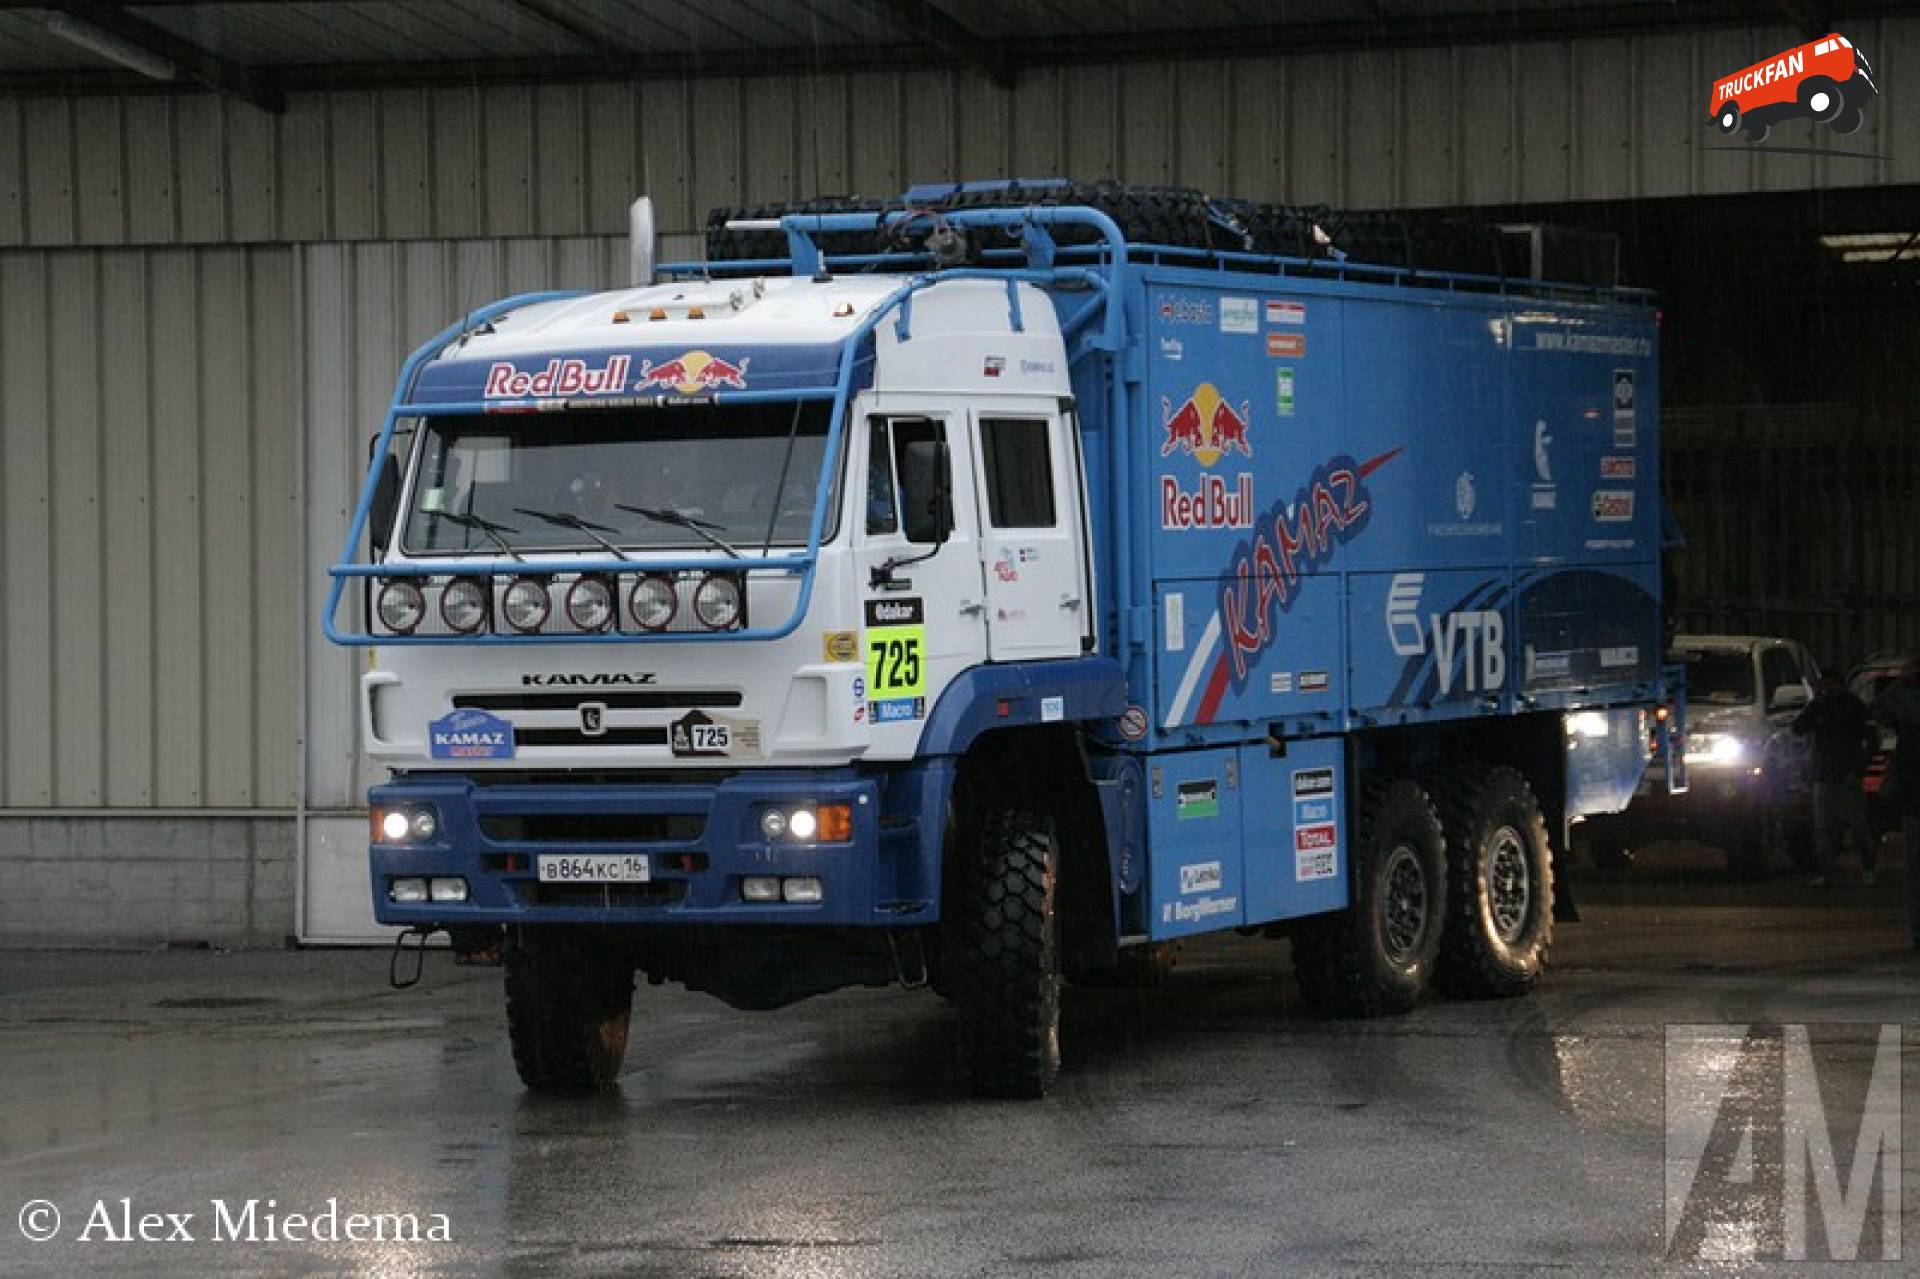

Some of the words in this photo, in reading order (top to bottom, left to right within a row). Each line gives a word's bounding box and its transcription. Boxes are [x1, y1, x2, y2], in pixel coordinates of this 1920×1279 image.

[485, 361, 560, 397] Red
[556, 355, 631, 394] Bull
[1161, 474, 1208, 530] Red
[1208, 473, 1254, 528] Bull
[1223, 469, 1369, 680] KAMAZ
[870, 638, 920, 690] 725
[1430, 611, 1506, 695] VTB
[522, 672, 657, 685] KAMAZ
[435, 732, 505, 746] KAMAZ
[694, 726, 729, 748] 725
